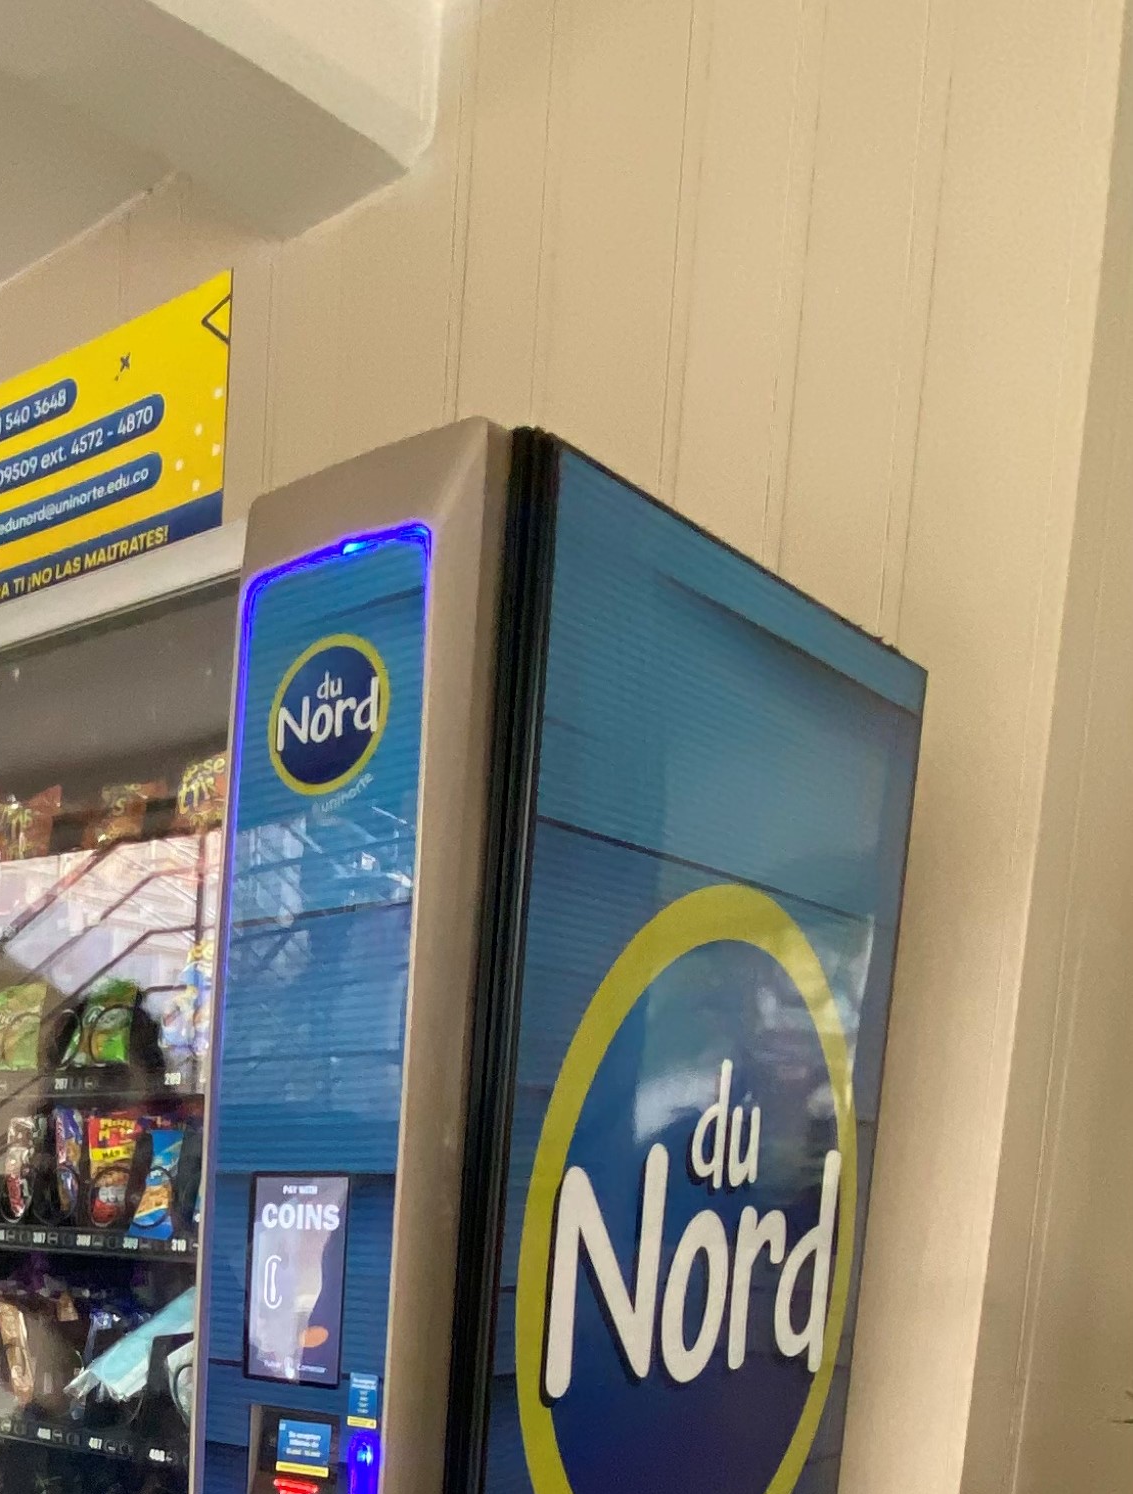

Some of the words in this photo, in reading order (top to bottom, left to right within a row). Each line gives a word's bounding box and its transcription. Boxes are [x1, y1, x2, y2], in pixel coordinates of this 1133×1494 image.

[5, 406, 31, 432] 540
[33, 388, 67, 418] 3648
[40, 446, 67, 470] ext.
[70, 428, 104, 456] 4572
[117, 405, 154, 436] 4870
[13, 576, 25, 594] TI
[55, 556, 82, 581] LAS
[84, 525, 170, 571] MALTRATES!
[277, 676, 380, 751] Nord
[317, 670, 343, 700] du
[691, 1058, 761, 1190] du
[261, 1203, 341, 1232] COINS
[546, 1143, 842, 1399] Nord
